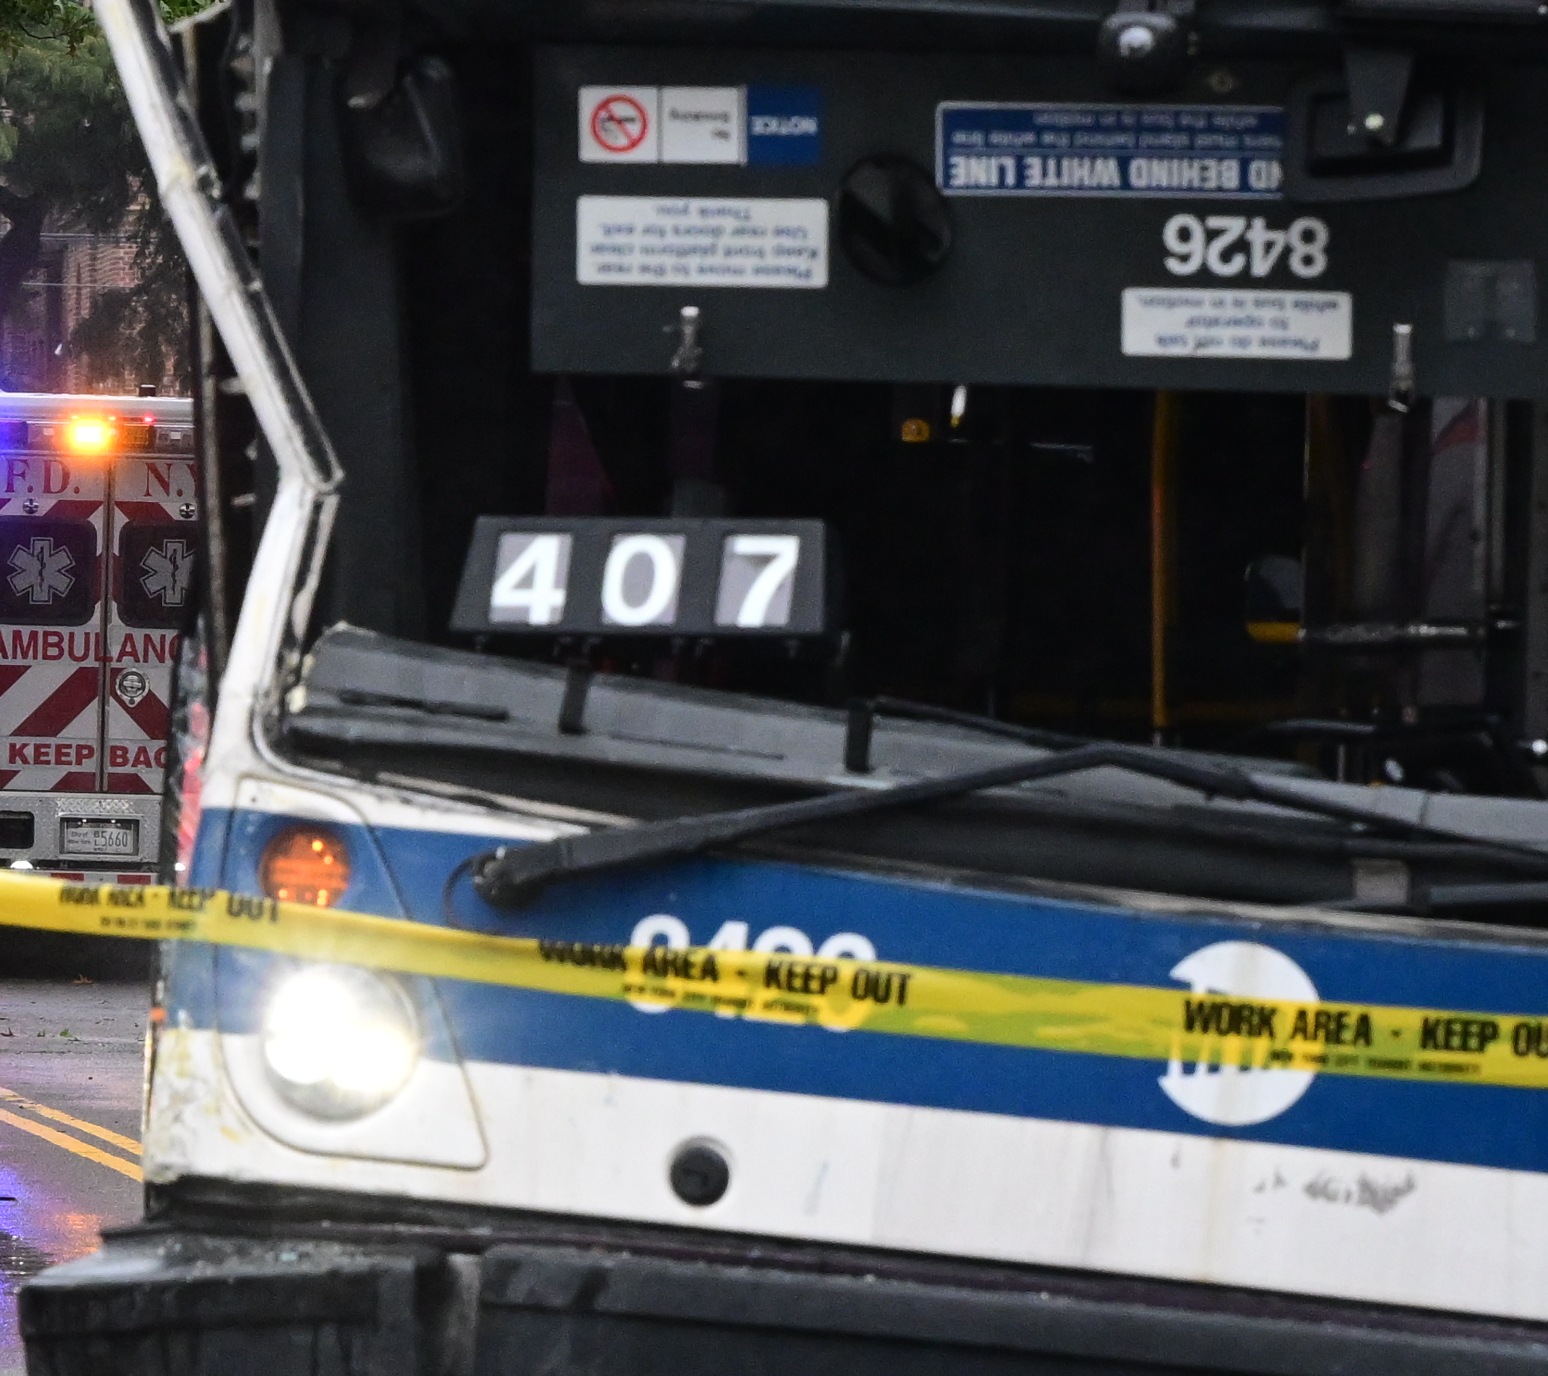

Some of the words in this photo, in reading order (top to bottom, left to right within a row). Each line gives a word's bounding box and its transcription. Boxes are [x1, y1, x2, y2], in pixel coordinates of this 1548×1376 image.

[949, 155, 1017, 186] LINE
[1024, 156, 1121, 187] WHITE
[1129, 157, 1240, 190] BEHIND
[1163, 213, 1329, 279] 8426
[5, 458, 81, 495] F.D.
[488, 532, 803, 630] 407
[9, 742, 96, 766] KEEP
[642, 945, 720, 982] AREA
[763, 957, 839, 995] KEEP
[850, 966, 913, 1007] OUT
[1183, 998, 1277, 1039] WORK
[1290, 1009, 1373, 1048] AREA
[1418, 1015, 1501, 1054] KEEP
